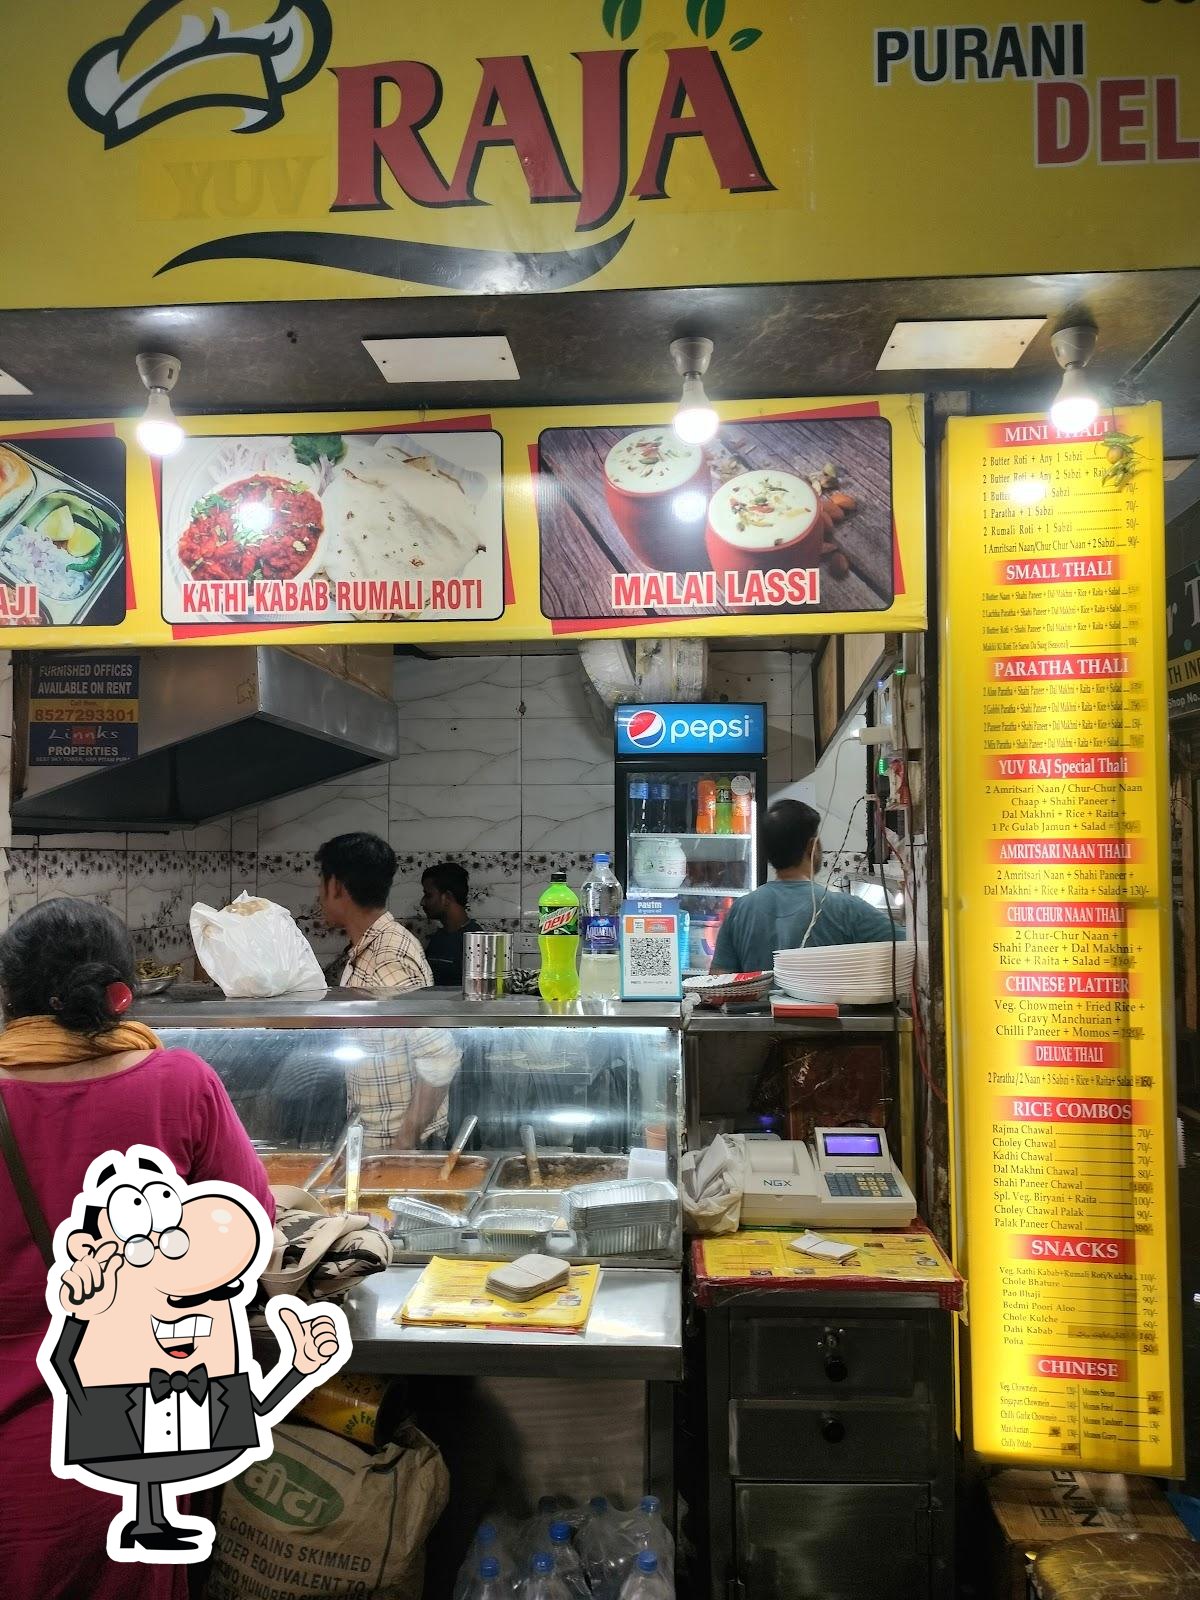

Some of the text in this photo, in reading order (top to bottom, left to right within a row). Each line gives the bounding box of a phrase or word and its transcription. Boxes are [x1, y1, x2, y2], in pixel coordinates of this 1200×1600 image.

[877, 23, 1085, 85] PURANI
[328, 46, 779, 232] RAJA
[1005, 426, 1048, 442] MINI
[990, 453, 1083, 466] Butter Roti Any Sabzi
[990, 470, 1081, 484] Butter Sabzi
[1052, 488, 1070, 497] Sabzi
[991, 506, 1054, 518] Paratha Sabzi
[991, 522, 1072, 536] Rumali Roti Sabzi
[1098, 538, 1115, 548] Sabzi
[1006, 561, 1112, 580] SMALL THALI
[612, 568, 820, 608] MALAI LASSI
[182, 579, 483, 614] KATHI KABAB RUMALI ROTI
[39, 664, 132, 676] FURNISHED OFFICES
[994, 658, 1128, 677] PARATHA THALI
[38, 682, 132, 694] AVAILABLE ON RENT
[35, 709, 134, 721] 8527293301
[670, 715, 750, 746] pepsi
[48, 747, 118, 756] PROPERTIES
[999, 758, 1128, 778] YUV RAJ Special Thali
[993, 784, 1142, 793] Amritsari Naan Chur-Chur Naan
[1012, 797, 1108, 808] Chaap Shahi Paneer
[1002, 809, 1119, 819] Dal Makhni Rice Raita
[999, 822, 1106, 832] Pc Gulab Jamun Salad
[1000, 844, 1132, 859] AMRITSARI NAAN THALI
[1004, 870, 1126, 881] Amritsari Naan Shahi Paneer
[984, 886, 1150, 898] Dal Makhni Rice Raita 130/-
[1008, 907, 1124, 922] CHUR CHUR NAAN THALI
[1024, 931, 1109, 940] Chur-Chur Naan
[993, 943, 1133, 953] Shahi Paneer Dal Makhni
[1000, 956, 1100, 966] Rice Raita Salad
[1005, 976, 1129, 993] CHINESE PLATTER
[995, 1000, 1136, 1012] Veg. Chowmein Fried Rice
[1018, 1013, 1112, 1026] Gravy Manchurian
[996, 1026, 1110, 1037] Chilli Paneer Momos
[1035, 1046, 1103, 1062] DELUXE THALI
[1013, 1102, 1132, 1119] RICE COMBOS
[992, 1124, 1053, 1135] Rajma Chawal
[992, 1138, 1056, 1149] Choley Chawal
[993, 1151, 1053, 1161] Kadhi Chawal
[993, 1165, 1078, 1176] Dal Makhni Chawal
[763, 1179, 792, 1187] NGX
[993, 1178, 1082, 1190] Shahi Paneer Chawal
[993, 1192, 1097, 1204] Spl. Veg. Biryani Raita
[994, 1205, 1084, 1217] Choley Chawal Palak
[994, 1218, 1082, 1230] Palak Paneer Chawal
[1031, 1240, 1119, 1258] SNACKS
[1016, 1267, 1036, 1276] Kathi
[1002, 1278, 1060, 1287] Chole Bhature
[1003, 1289, 1041, 1299] Pao Bhaji
[1003, 1301, 1075, 1312] Bedmi Poori Aloo
[1003, 1313, 1058, 1323] Chole Kulche
[1003, 1325, 1053, 1335] Dahi Kabab
[1004, 1337, 1024, 1345] Poha
[1038, 1360, 1118, 1377] CHINESE
[230, 1516, 371, 1572] CONTAINS SKIMMED
[250, 1553, 365, 1594] EQUIVALENT TO
